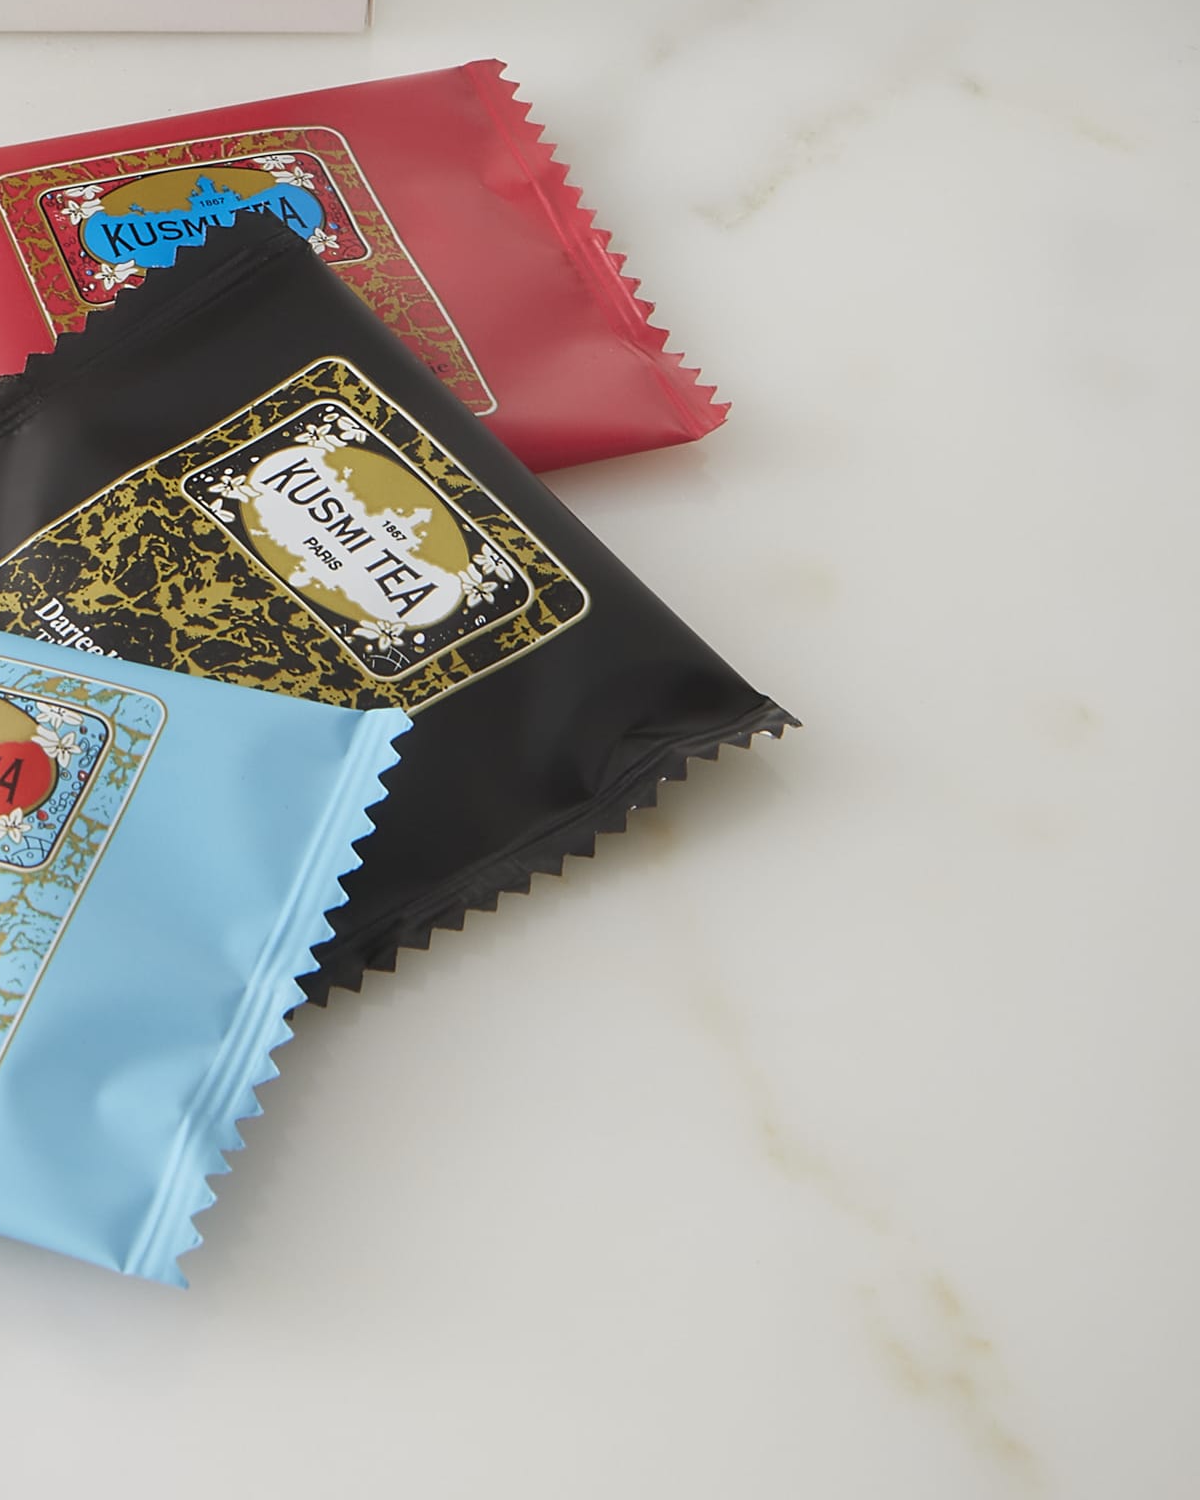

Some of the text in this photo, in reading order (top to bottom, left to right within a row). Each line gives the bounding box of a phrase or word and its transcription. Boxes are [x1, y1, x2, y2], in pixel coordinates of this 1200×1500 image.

[200, 197, 225, 207] 1867
[260, 457, 439, 619] KUSMI TEA
[382, 520, 408, 542] 1867
[303, 536, 343, 571] PARIS
